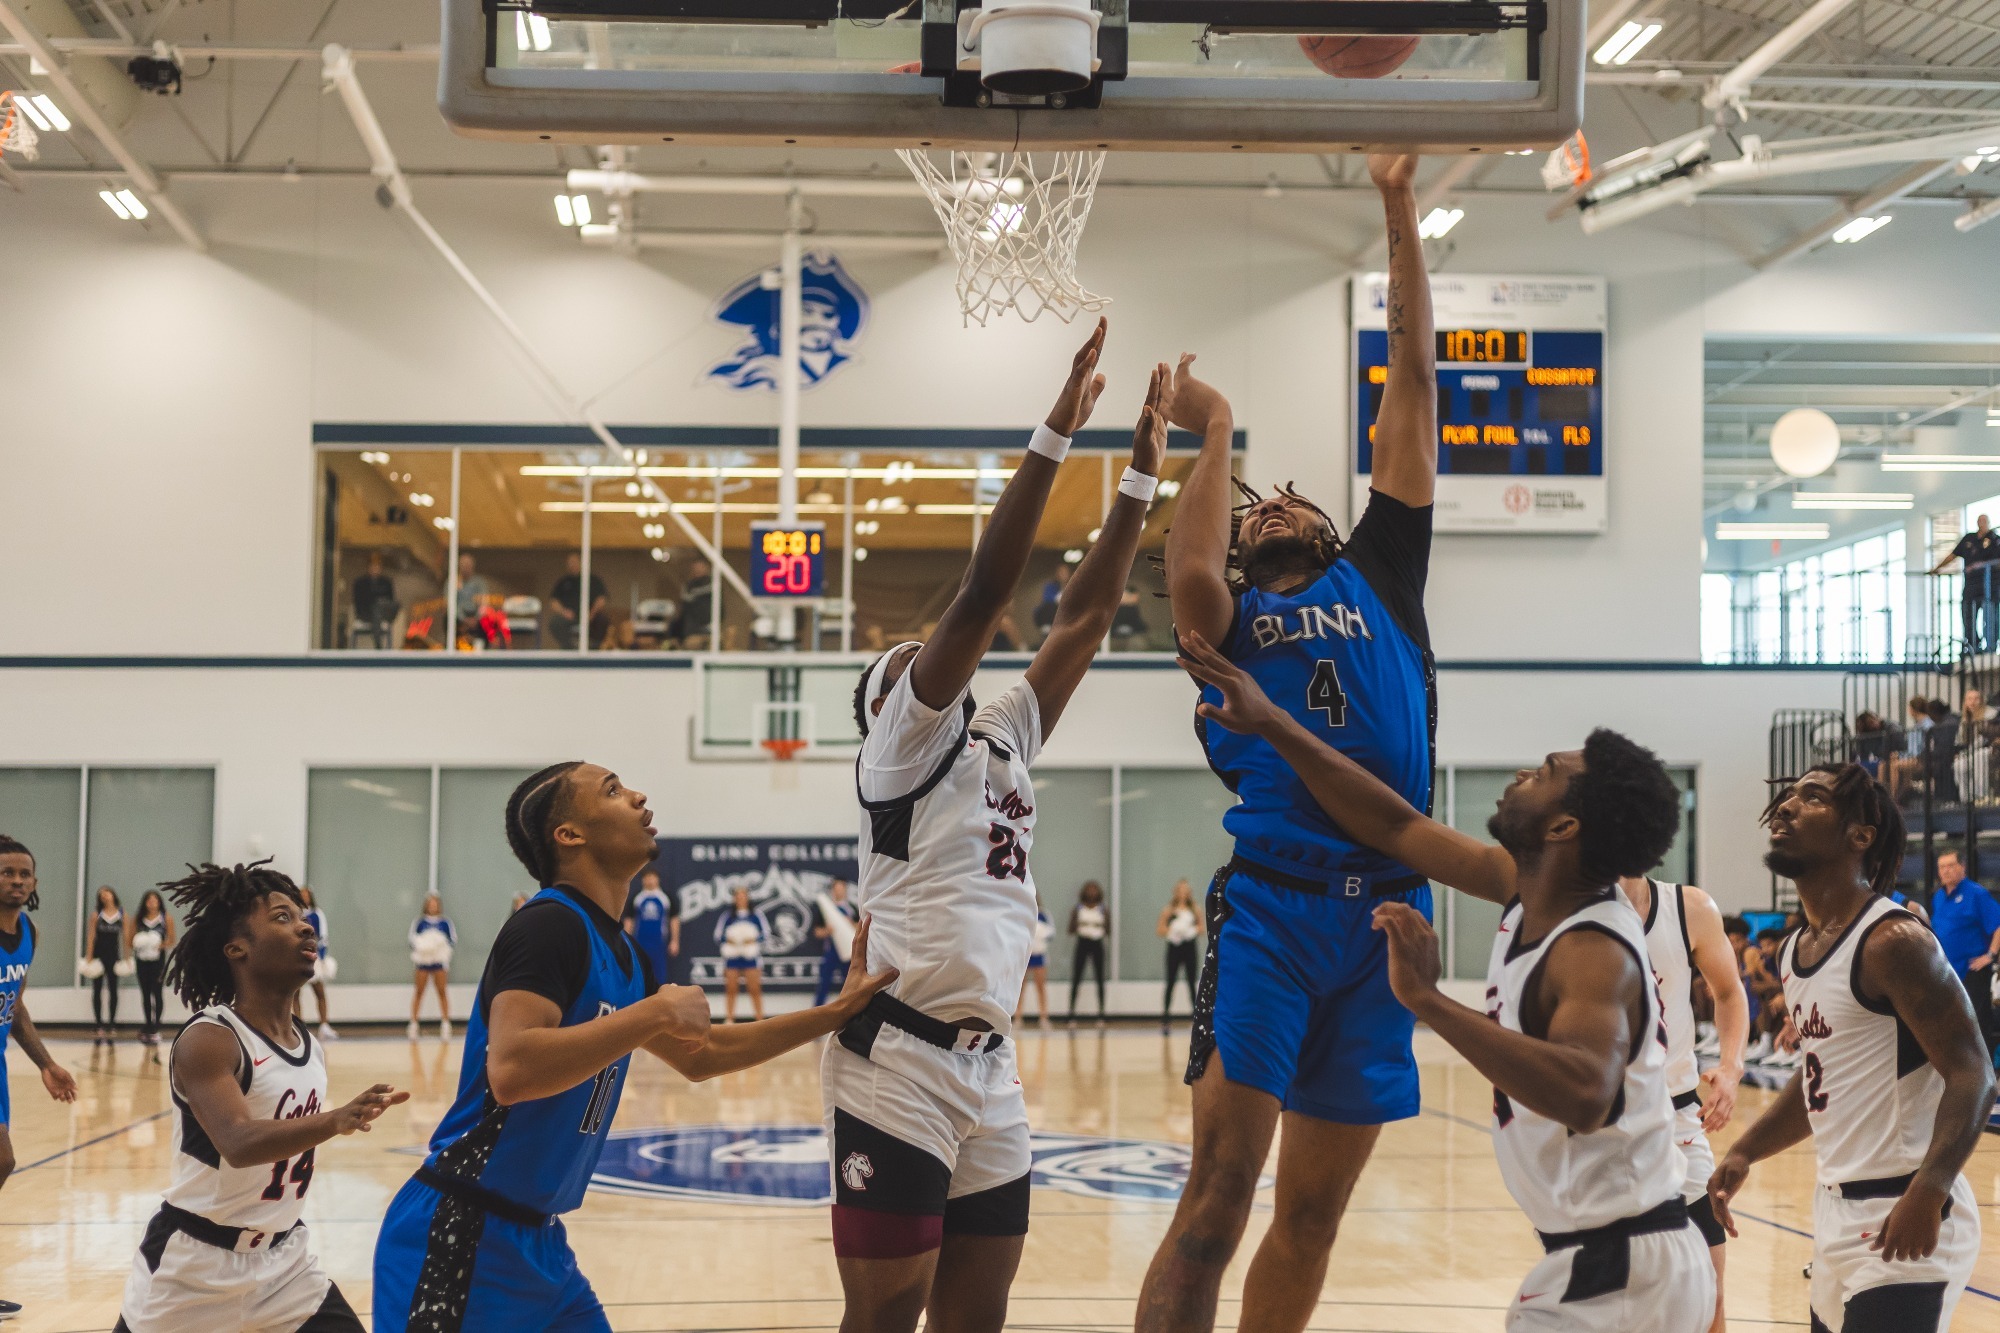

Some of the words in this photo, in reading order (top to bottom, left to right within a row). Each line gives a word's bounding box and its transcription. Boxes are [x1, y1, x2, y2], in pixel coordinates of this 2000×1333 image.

[1447, 329, 1526, 362] 10:01
[763, 531, 820, 556] 10:01
[764, 554, 811, 594] 20
[1252, 602, 1373, 650] BLINN
[1307, 659, 1347, 727] 4
[691, 844, 759, 862] BLINN
[1344, 876, 1362, 897] B
[1793, 1002, 1832, 1040] Colts
[1806, 1051, 1829, 1113] 2
[261, 1147, 316, 1201] 14
